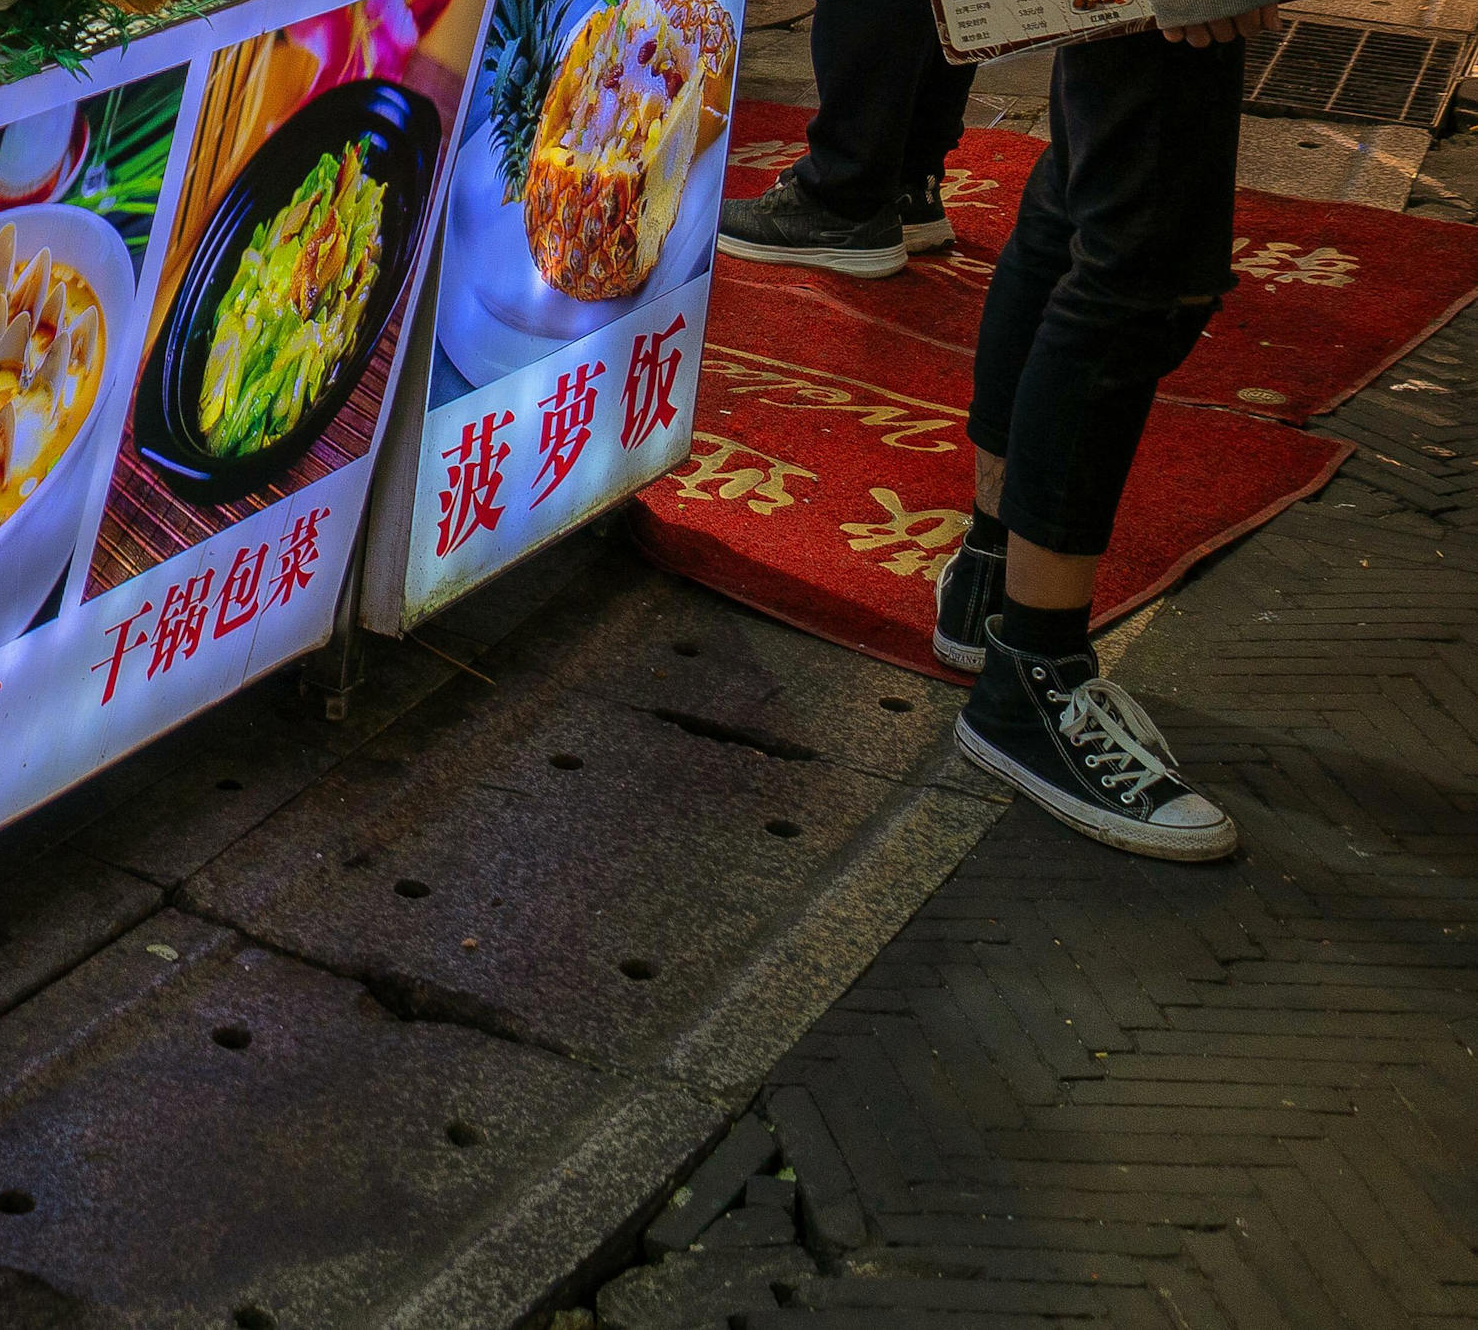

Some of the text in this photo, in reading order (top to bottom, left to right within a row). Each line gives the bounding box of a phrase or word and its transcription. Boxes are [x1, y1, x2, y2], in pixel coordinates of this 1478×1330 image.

[436, 312, 687, 559] 菠萝饭
[91, 507, 331, 707] 干锅包菜
